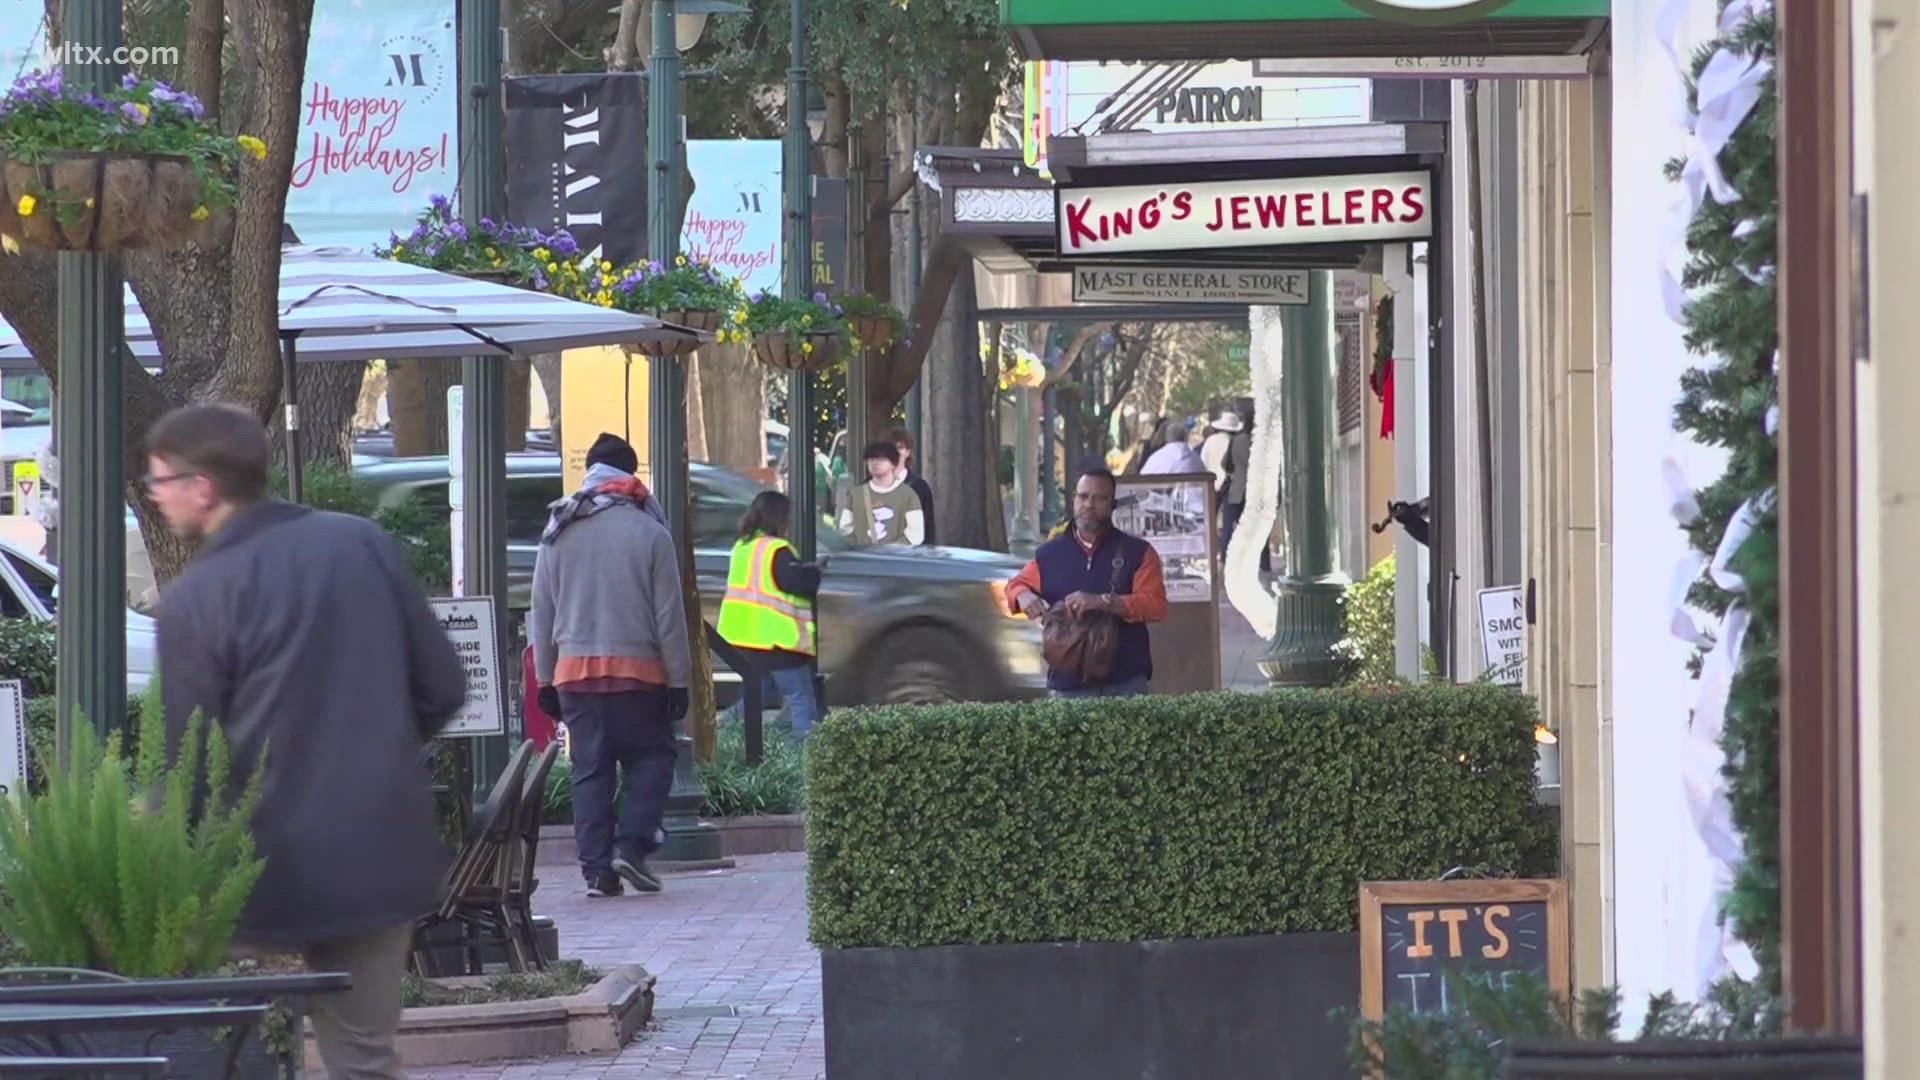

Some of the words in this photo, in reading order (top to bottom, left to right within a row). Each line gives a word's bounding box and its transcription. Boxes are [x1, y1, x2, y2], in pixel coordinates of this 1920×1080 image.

[306, 82, 407, 138] Happy
[1155, 85, 1263, 123] PATRON
[290, 126, 448, 193] Holidays!
[686, 209, 747, 245] Happy
[1205, 186, 1424, 231] JEWELERS
[1078, 271, 1138, 297] MAST
[1142, 271, 1231, 289] GENERAL
[1238, 274, 1305, 299] STORE
[1498, 638, 1521, 649] WIT
[1406, 905, 1511, 959] IT'S
